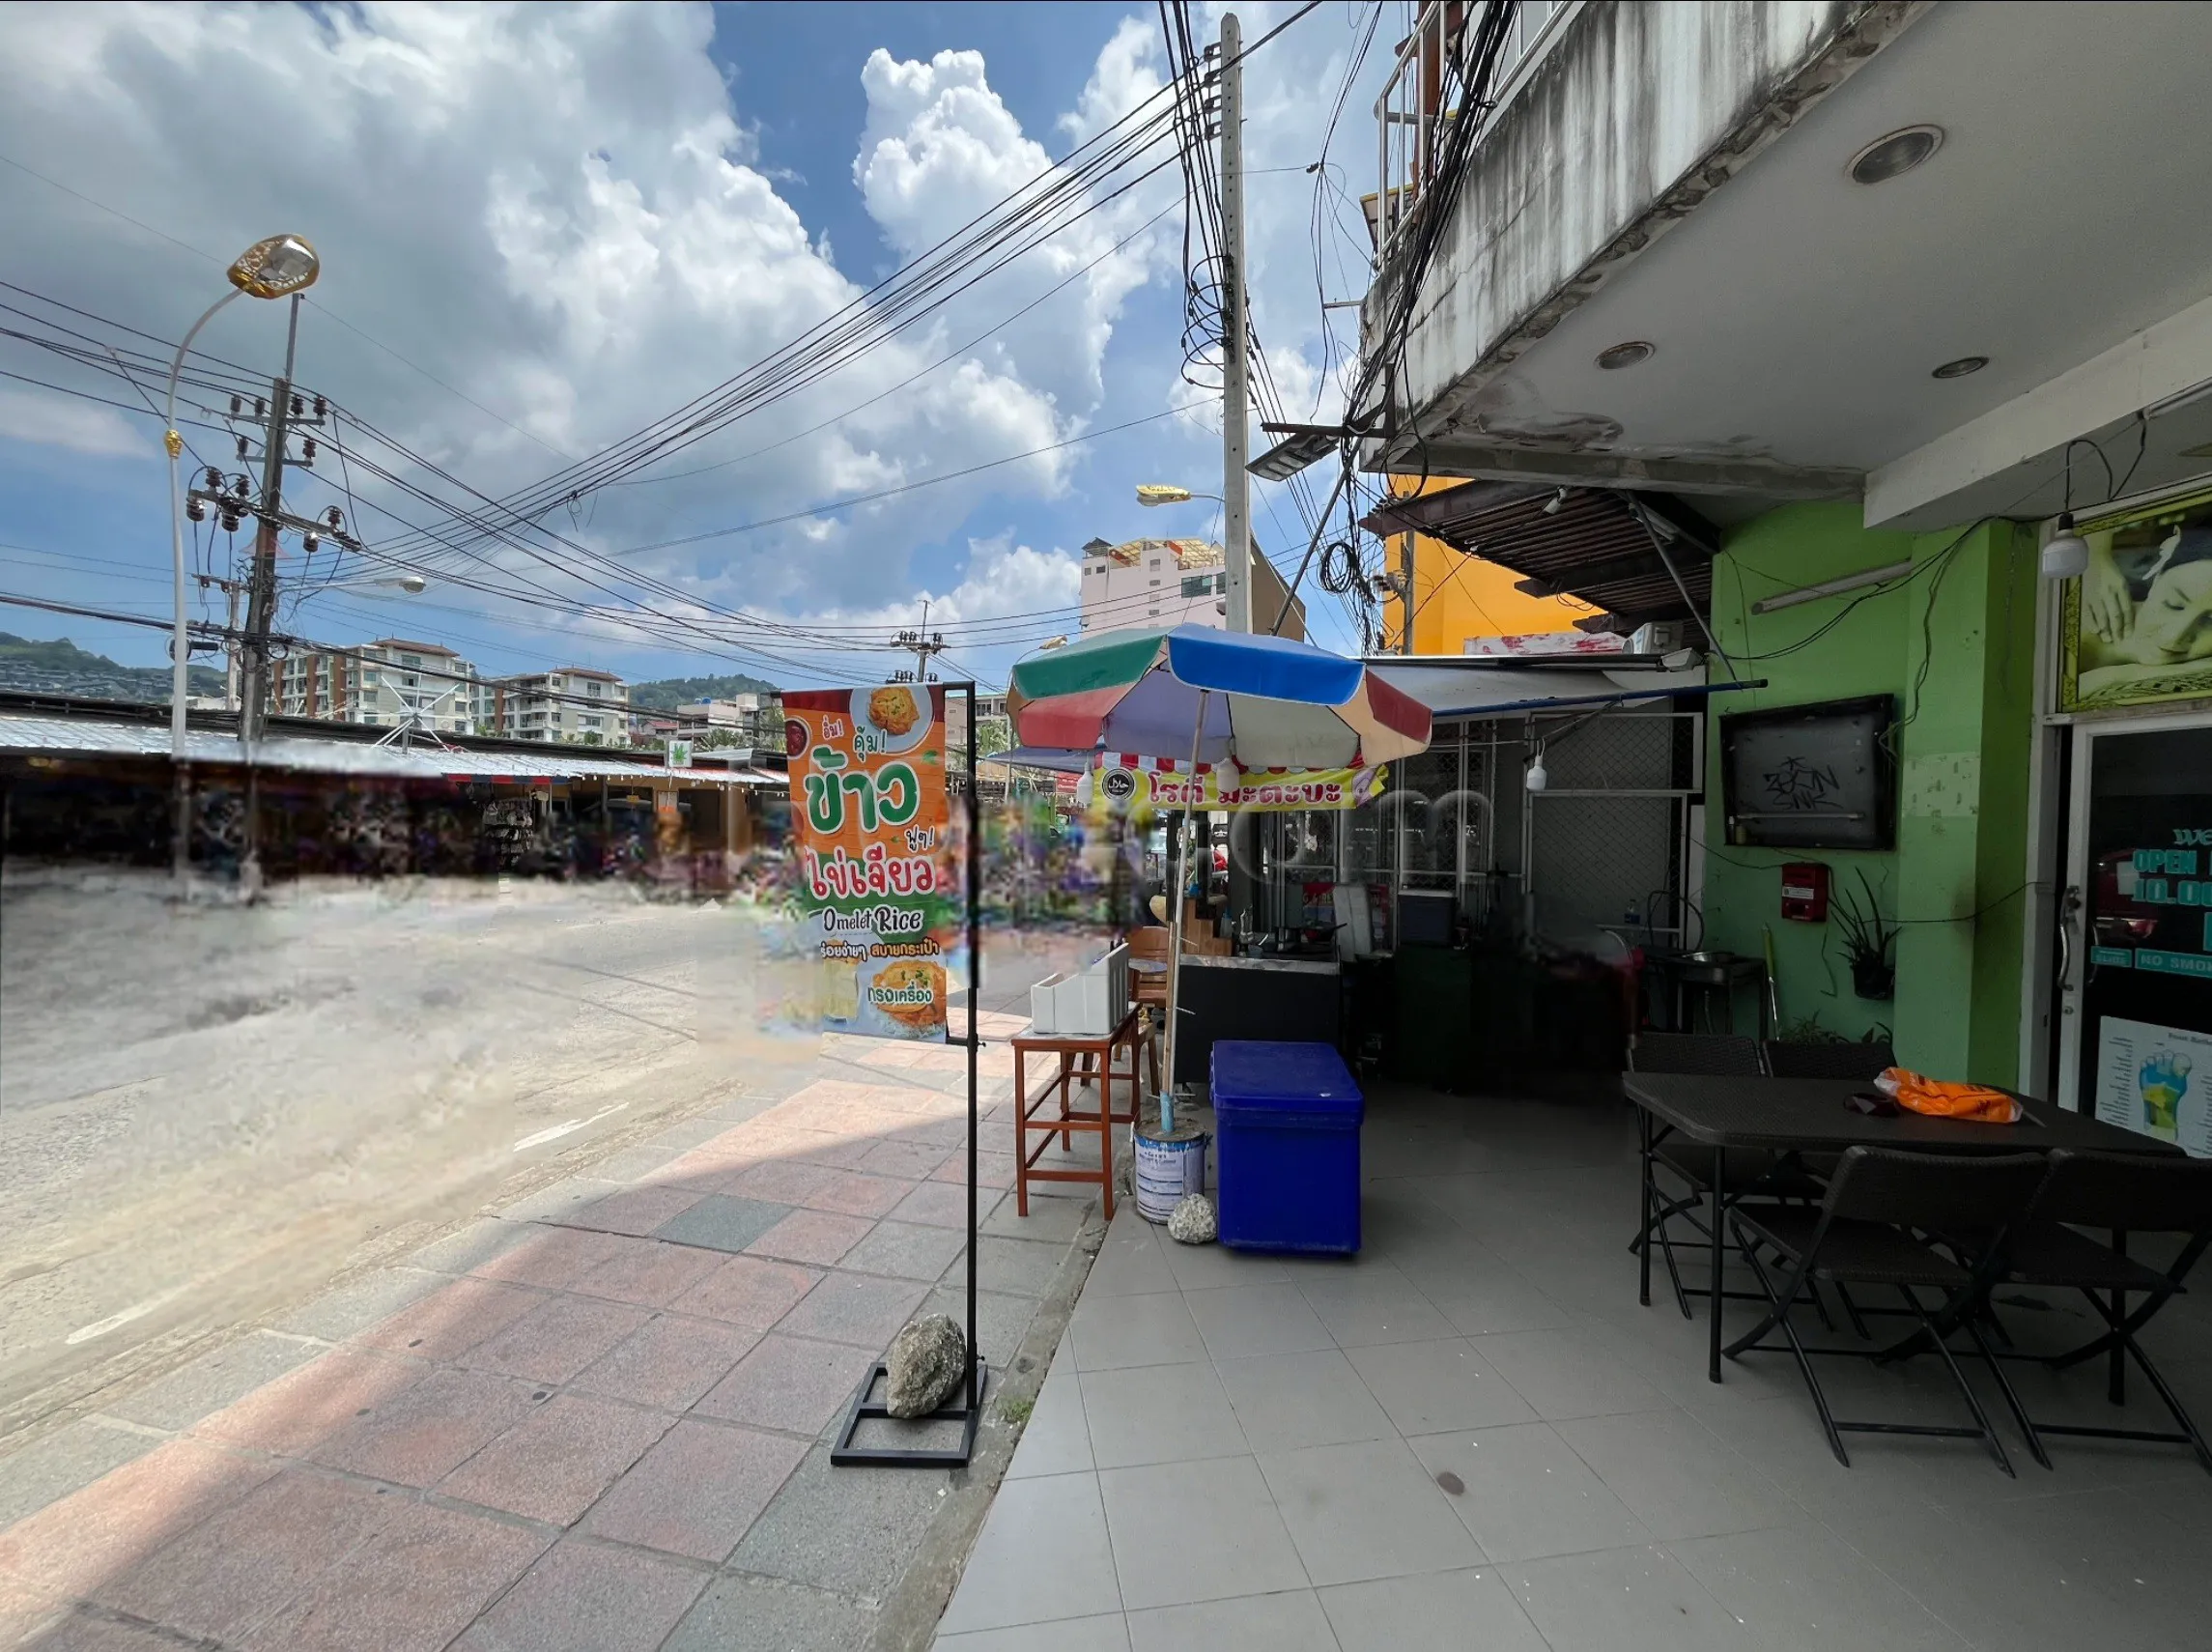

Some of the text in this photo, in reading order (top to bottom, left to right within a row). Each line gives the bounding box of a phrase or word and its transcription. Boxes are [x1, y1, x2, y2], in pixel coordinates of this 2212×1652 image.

[854, 726, 887, 761] คุ้ม!
[804, 746, 919, 832] ข้าว
[2133, 848, 2198, 875] OPEN
[824, 907, 922, 932] Omelet Rice
[2141, 954, 2163, 966] NO
